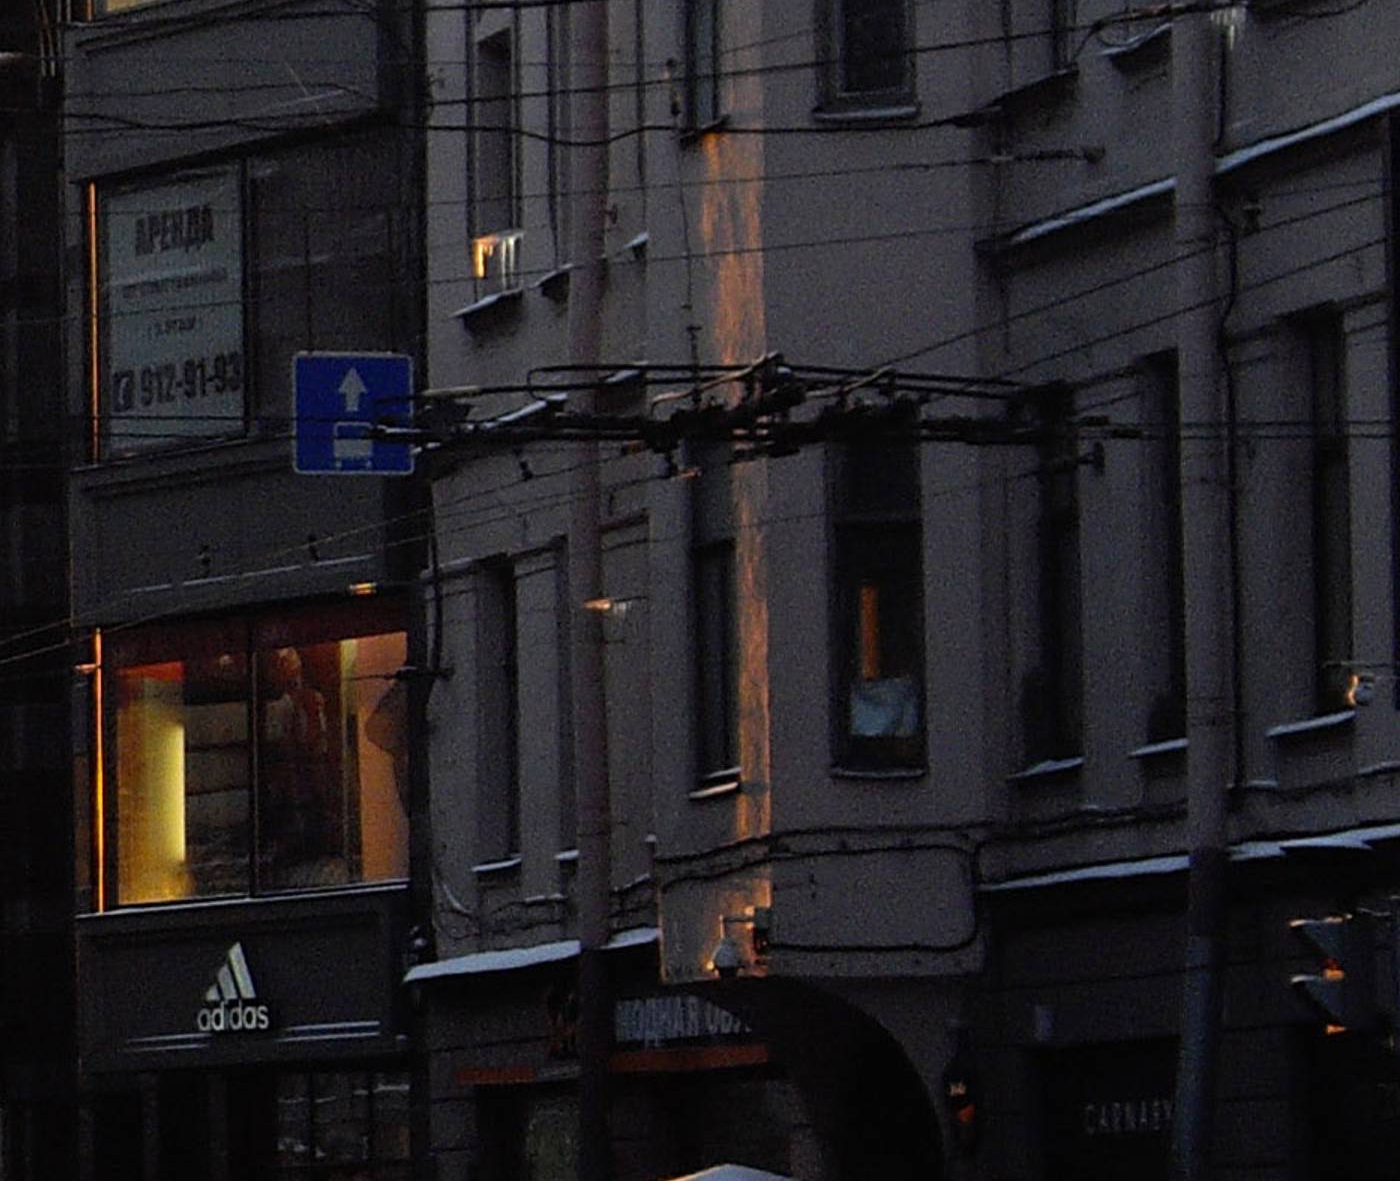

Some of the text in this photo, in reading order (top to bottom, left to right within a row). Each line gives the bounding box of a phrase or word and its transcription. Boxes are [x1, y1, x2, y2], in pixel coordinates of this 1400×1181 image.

[135, 204, 214, 256] АРЕНДА
[140, 352, 241, 407] 912-91-93
[197, 1001, 270, 1032] adidas
